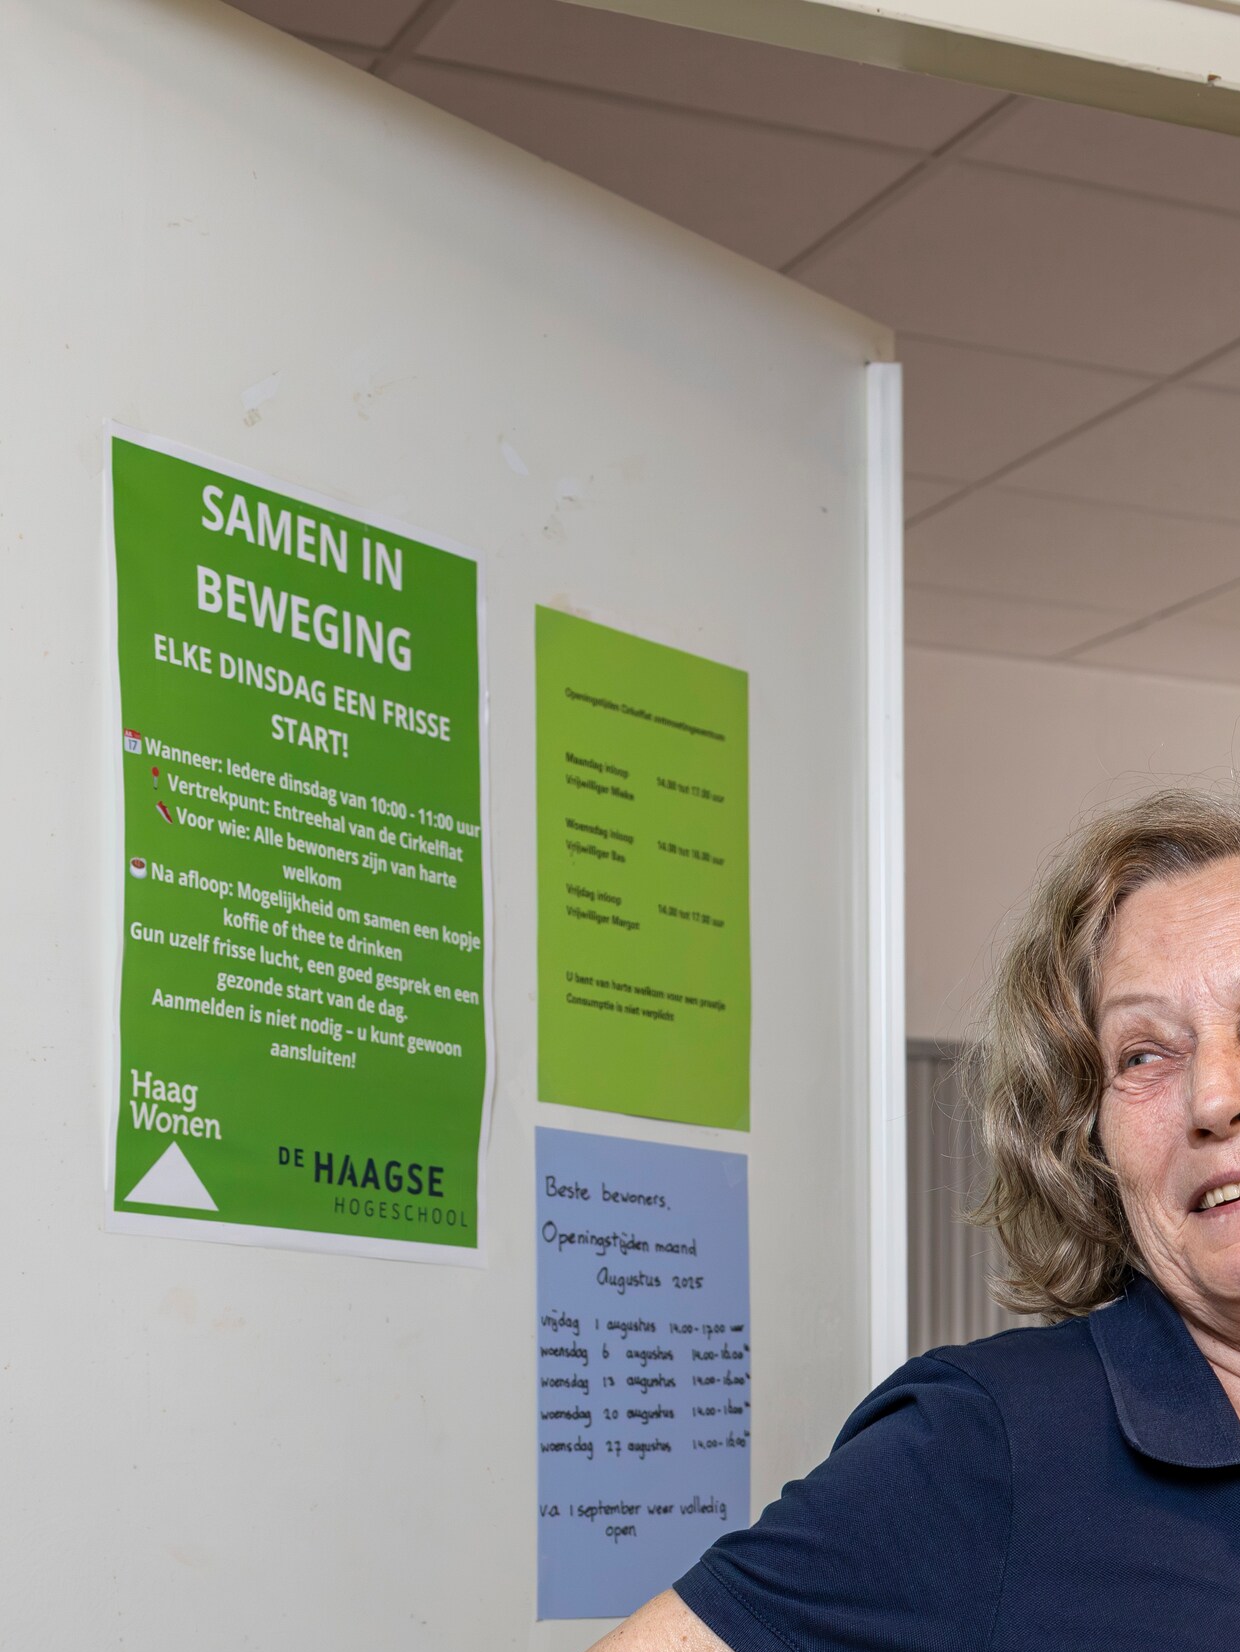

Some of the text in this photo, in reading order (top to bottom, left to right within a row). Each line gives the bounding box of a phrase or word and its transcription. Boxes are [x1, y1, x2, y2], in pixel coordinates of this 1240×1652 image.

[201, 484, 403, 592] SAMEN IN
[196, 564, 412, 672] BEWEGING
[154, 632, 451, 742] ELKE DINSDAG EEN FRISSE
[271, 713, 349, 758] START!
[145, 735, 481, 839] Wanneer: Iedere dinsdag van 10:00 11:00 uur
[167, 772, 463, 863] Vertrekpunt: Entreehal van de Cirkelflat
[176, 805, 457, 889] Voor wie: Alle bewoners zijn van harte
[282, 864, 342, 892] welkom
[151, 861, 481, 953] Na afloop: Mogelijkheid om samen een kopje
[223, 907, 403, 963] koffie of thee te drinken
[130, 920, 480, 1006] Gun uzelf frisse lucht, een goed gesprek en een
[151, 987, 463, 1058] Aanmelden is niet nodig u kunt gewoon
[216, 971, 408, 1024] gezonde start van de dag.
[270, 1040, 357, 1069] aansluiten!
[130, 1068, 198, 1113] Haag
[129, 1100, 222, 1141] Wonen
[278, 1146, 445, 1198] DE HAAGSE
[545, 1175, 591, 1201] Beste
[334, 1196, 468, 1228] HOGESCHOOL
[655, 1238, 698, 1257] maand
[679, 1495, 728, 1521] volledig
[605, 1524, 637, 1545] open
